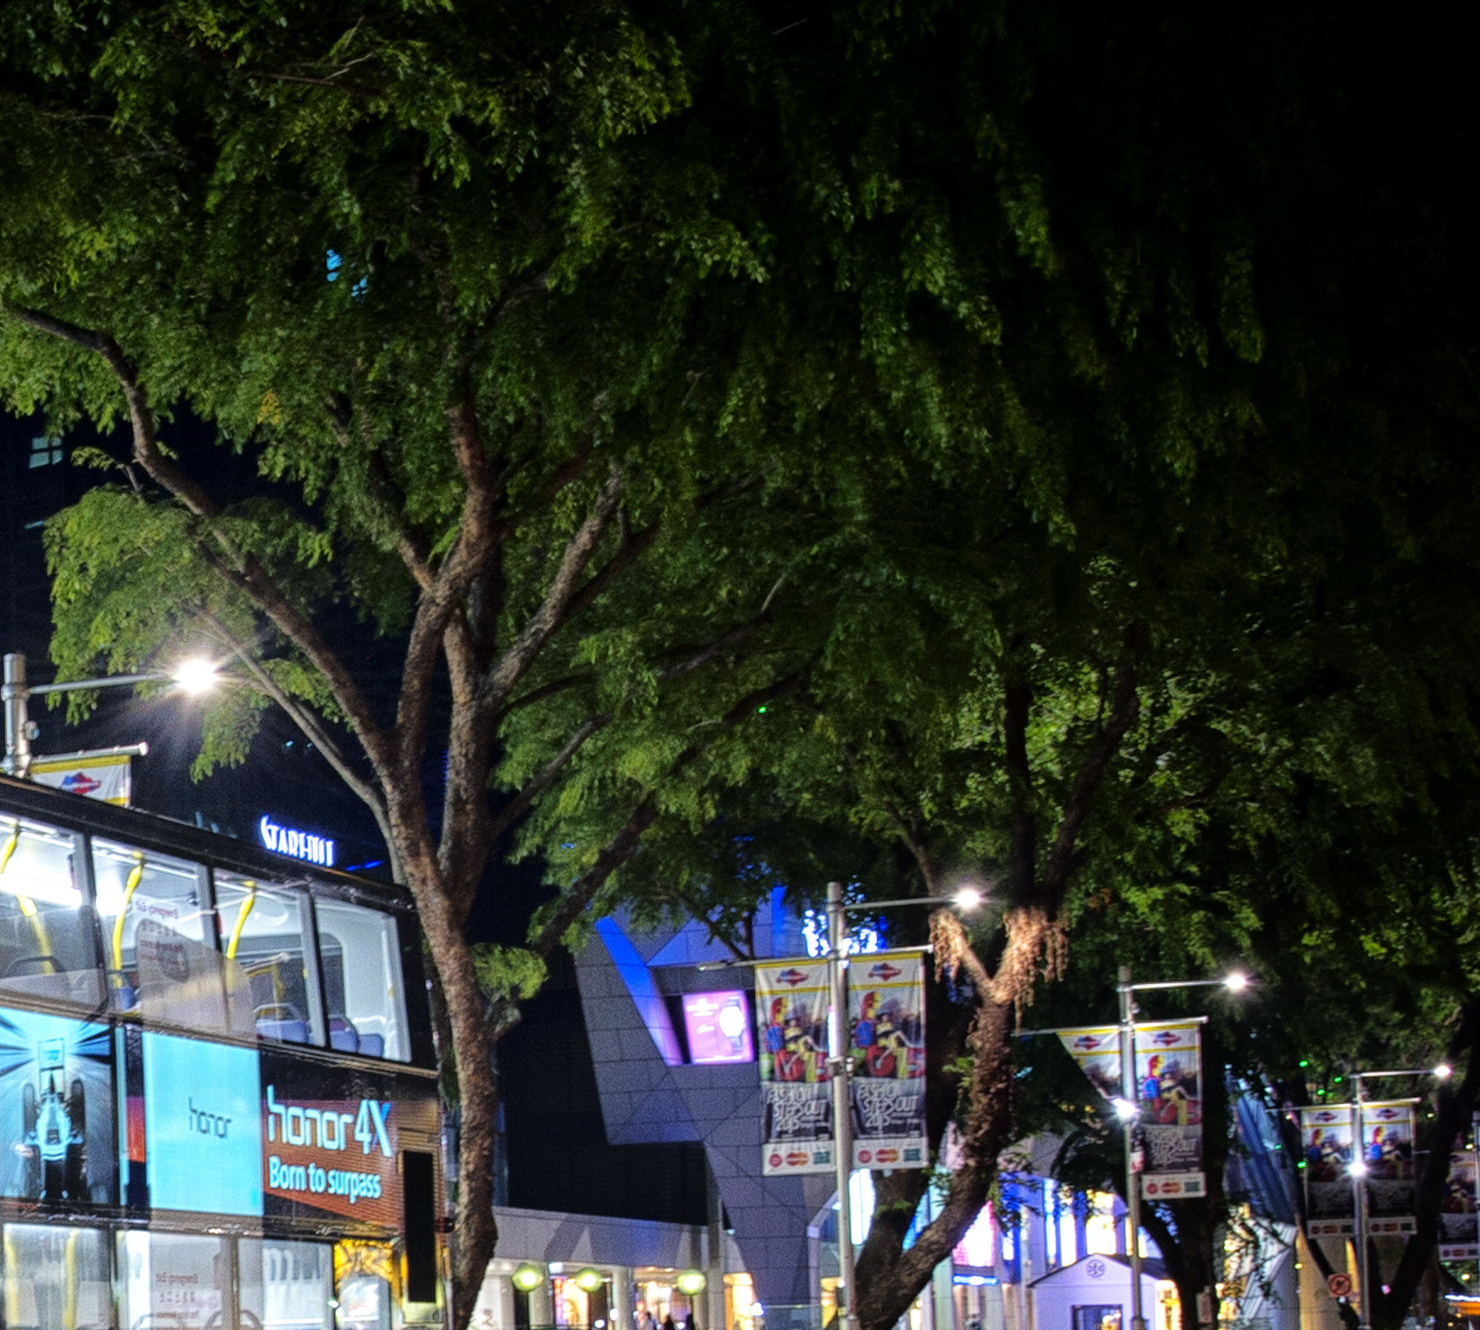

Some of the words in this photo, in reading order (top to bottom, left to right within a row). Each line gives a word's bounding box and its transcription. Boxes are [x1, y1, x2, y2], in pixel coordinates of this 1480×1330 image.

[188, 1096, 232, 1139] honor
[268, 1155, 307, 1191] Born
[307, 1162, 327, 1193] to
[327, 1168, 382, 1205] surpass
